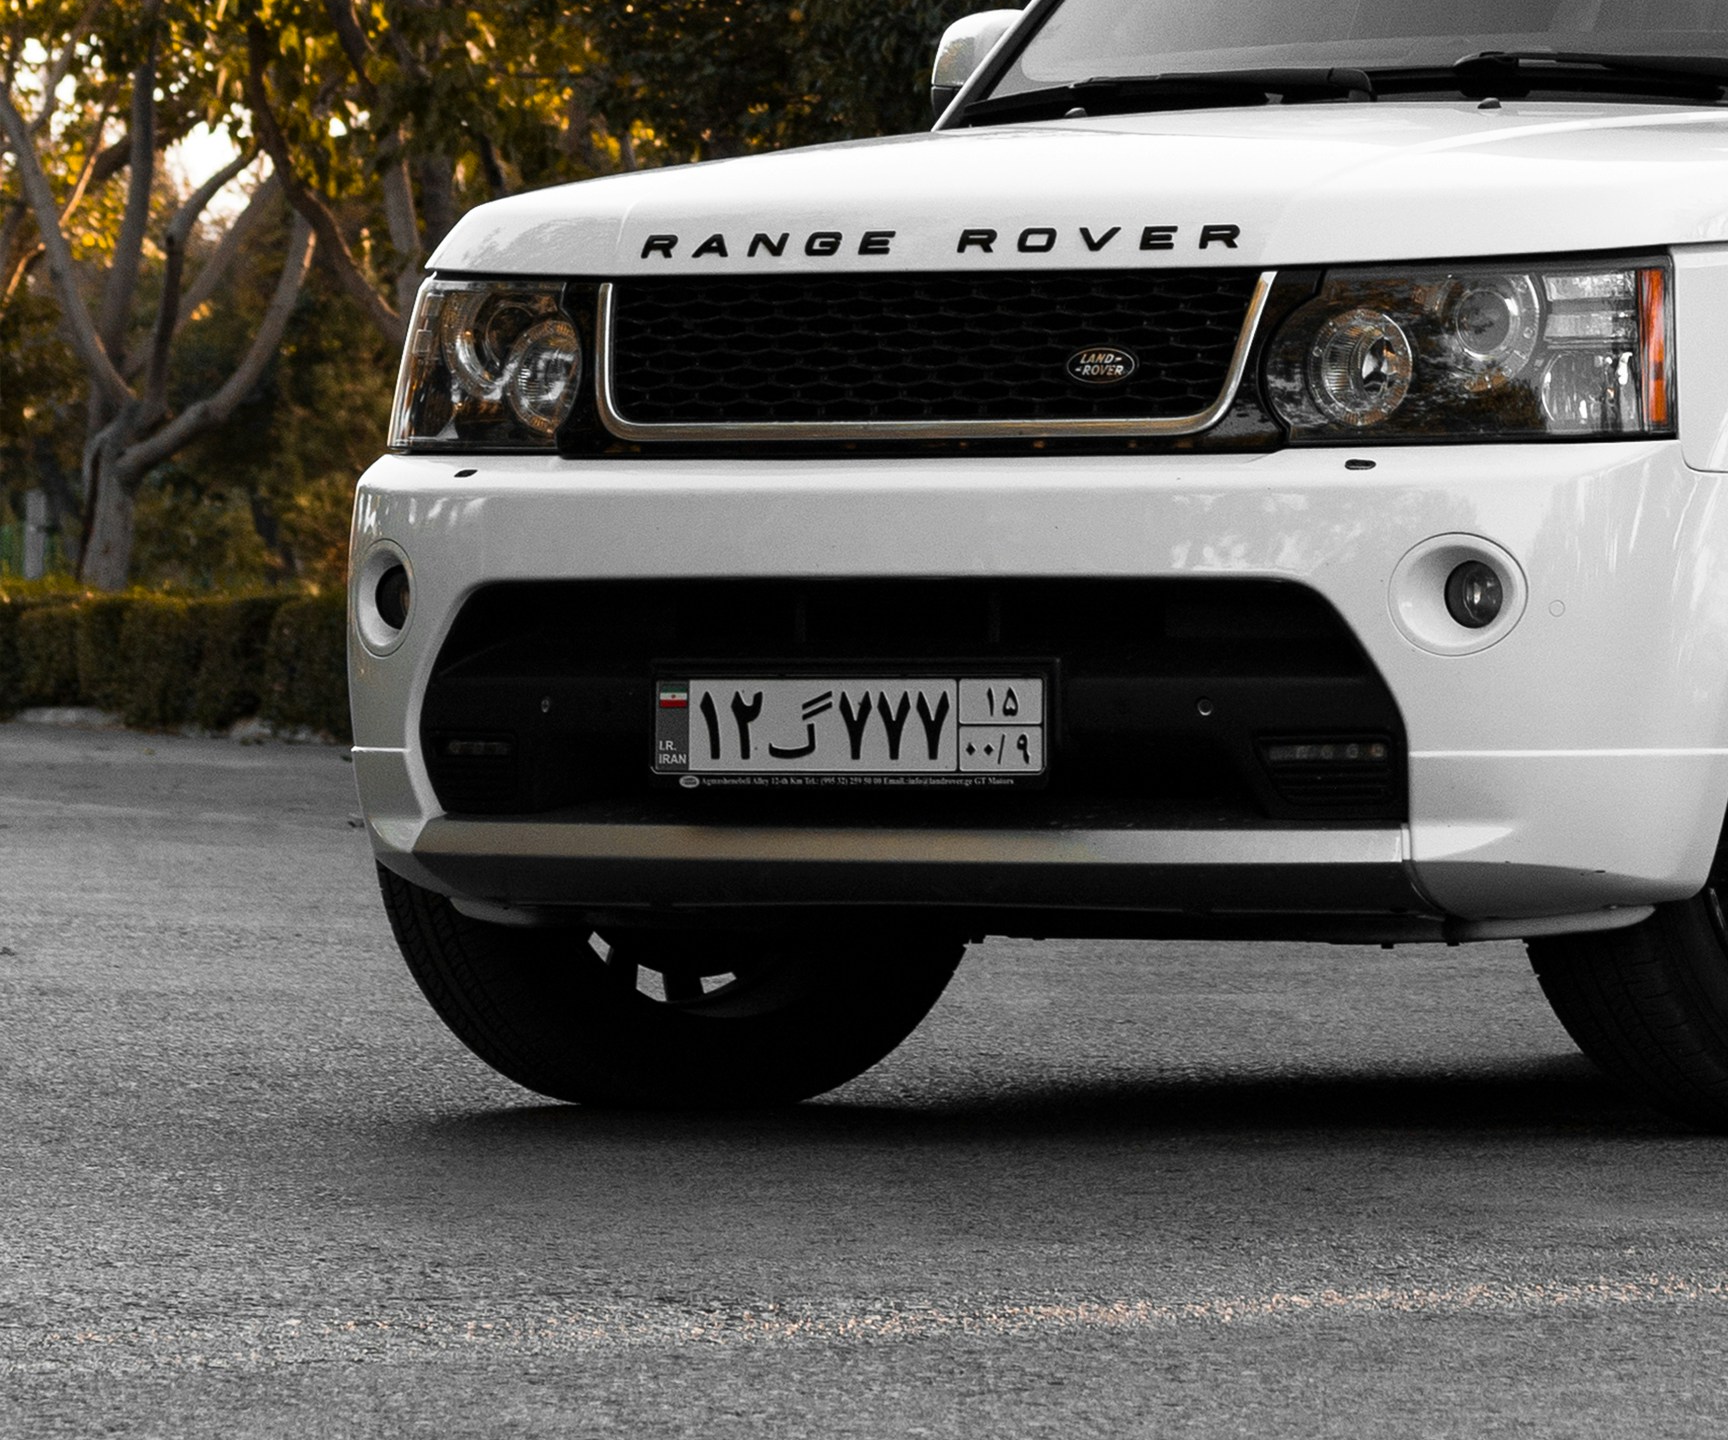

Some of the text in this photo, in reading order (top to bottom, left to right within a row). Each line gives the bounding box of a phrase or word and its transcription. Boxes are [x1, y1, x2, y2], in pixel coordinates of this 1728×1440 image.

[641, 223, 1241, 258] RANGE ROVER
[659, 740, 677, 751] I.R.
[658, 753, 687, 764] IRAN
